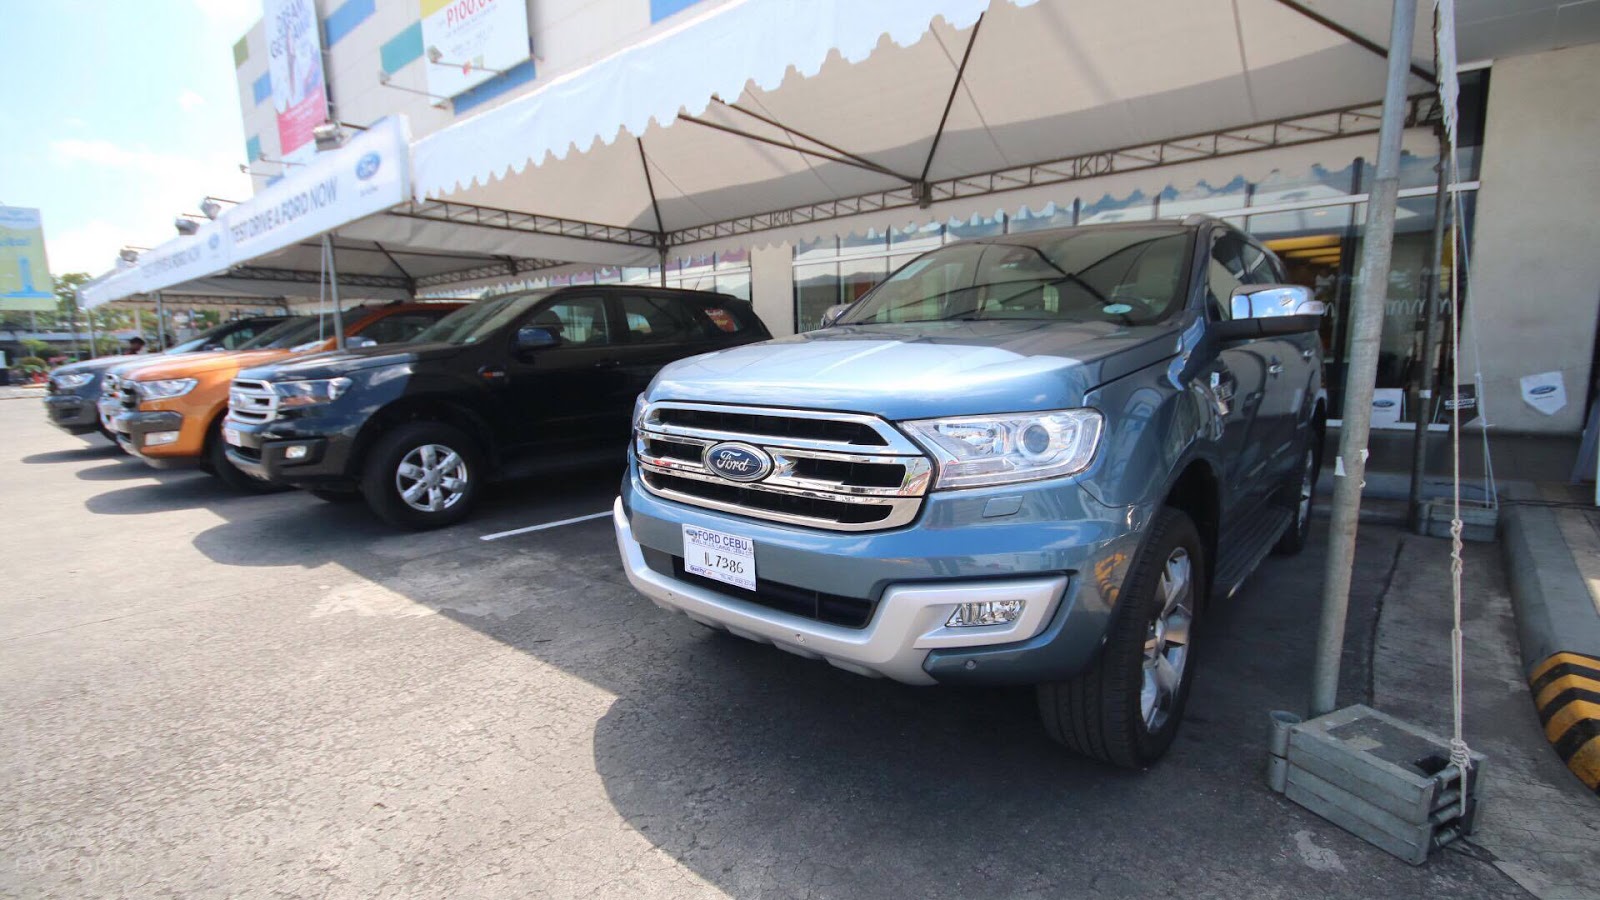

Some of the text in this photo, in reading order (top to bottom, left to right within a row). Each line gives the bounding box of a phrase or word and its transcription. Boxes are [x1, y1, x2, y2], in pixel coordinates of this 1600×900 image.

[310, 175, 339, 210] NOW
[716, 450, 750, 472] Ford
[698, 530, 721, 545] FORD
[723, 536, 748, 551] CEBU
[715, 555, 744, 574] 7386
